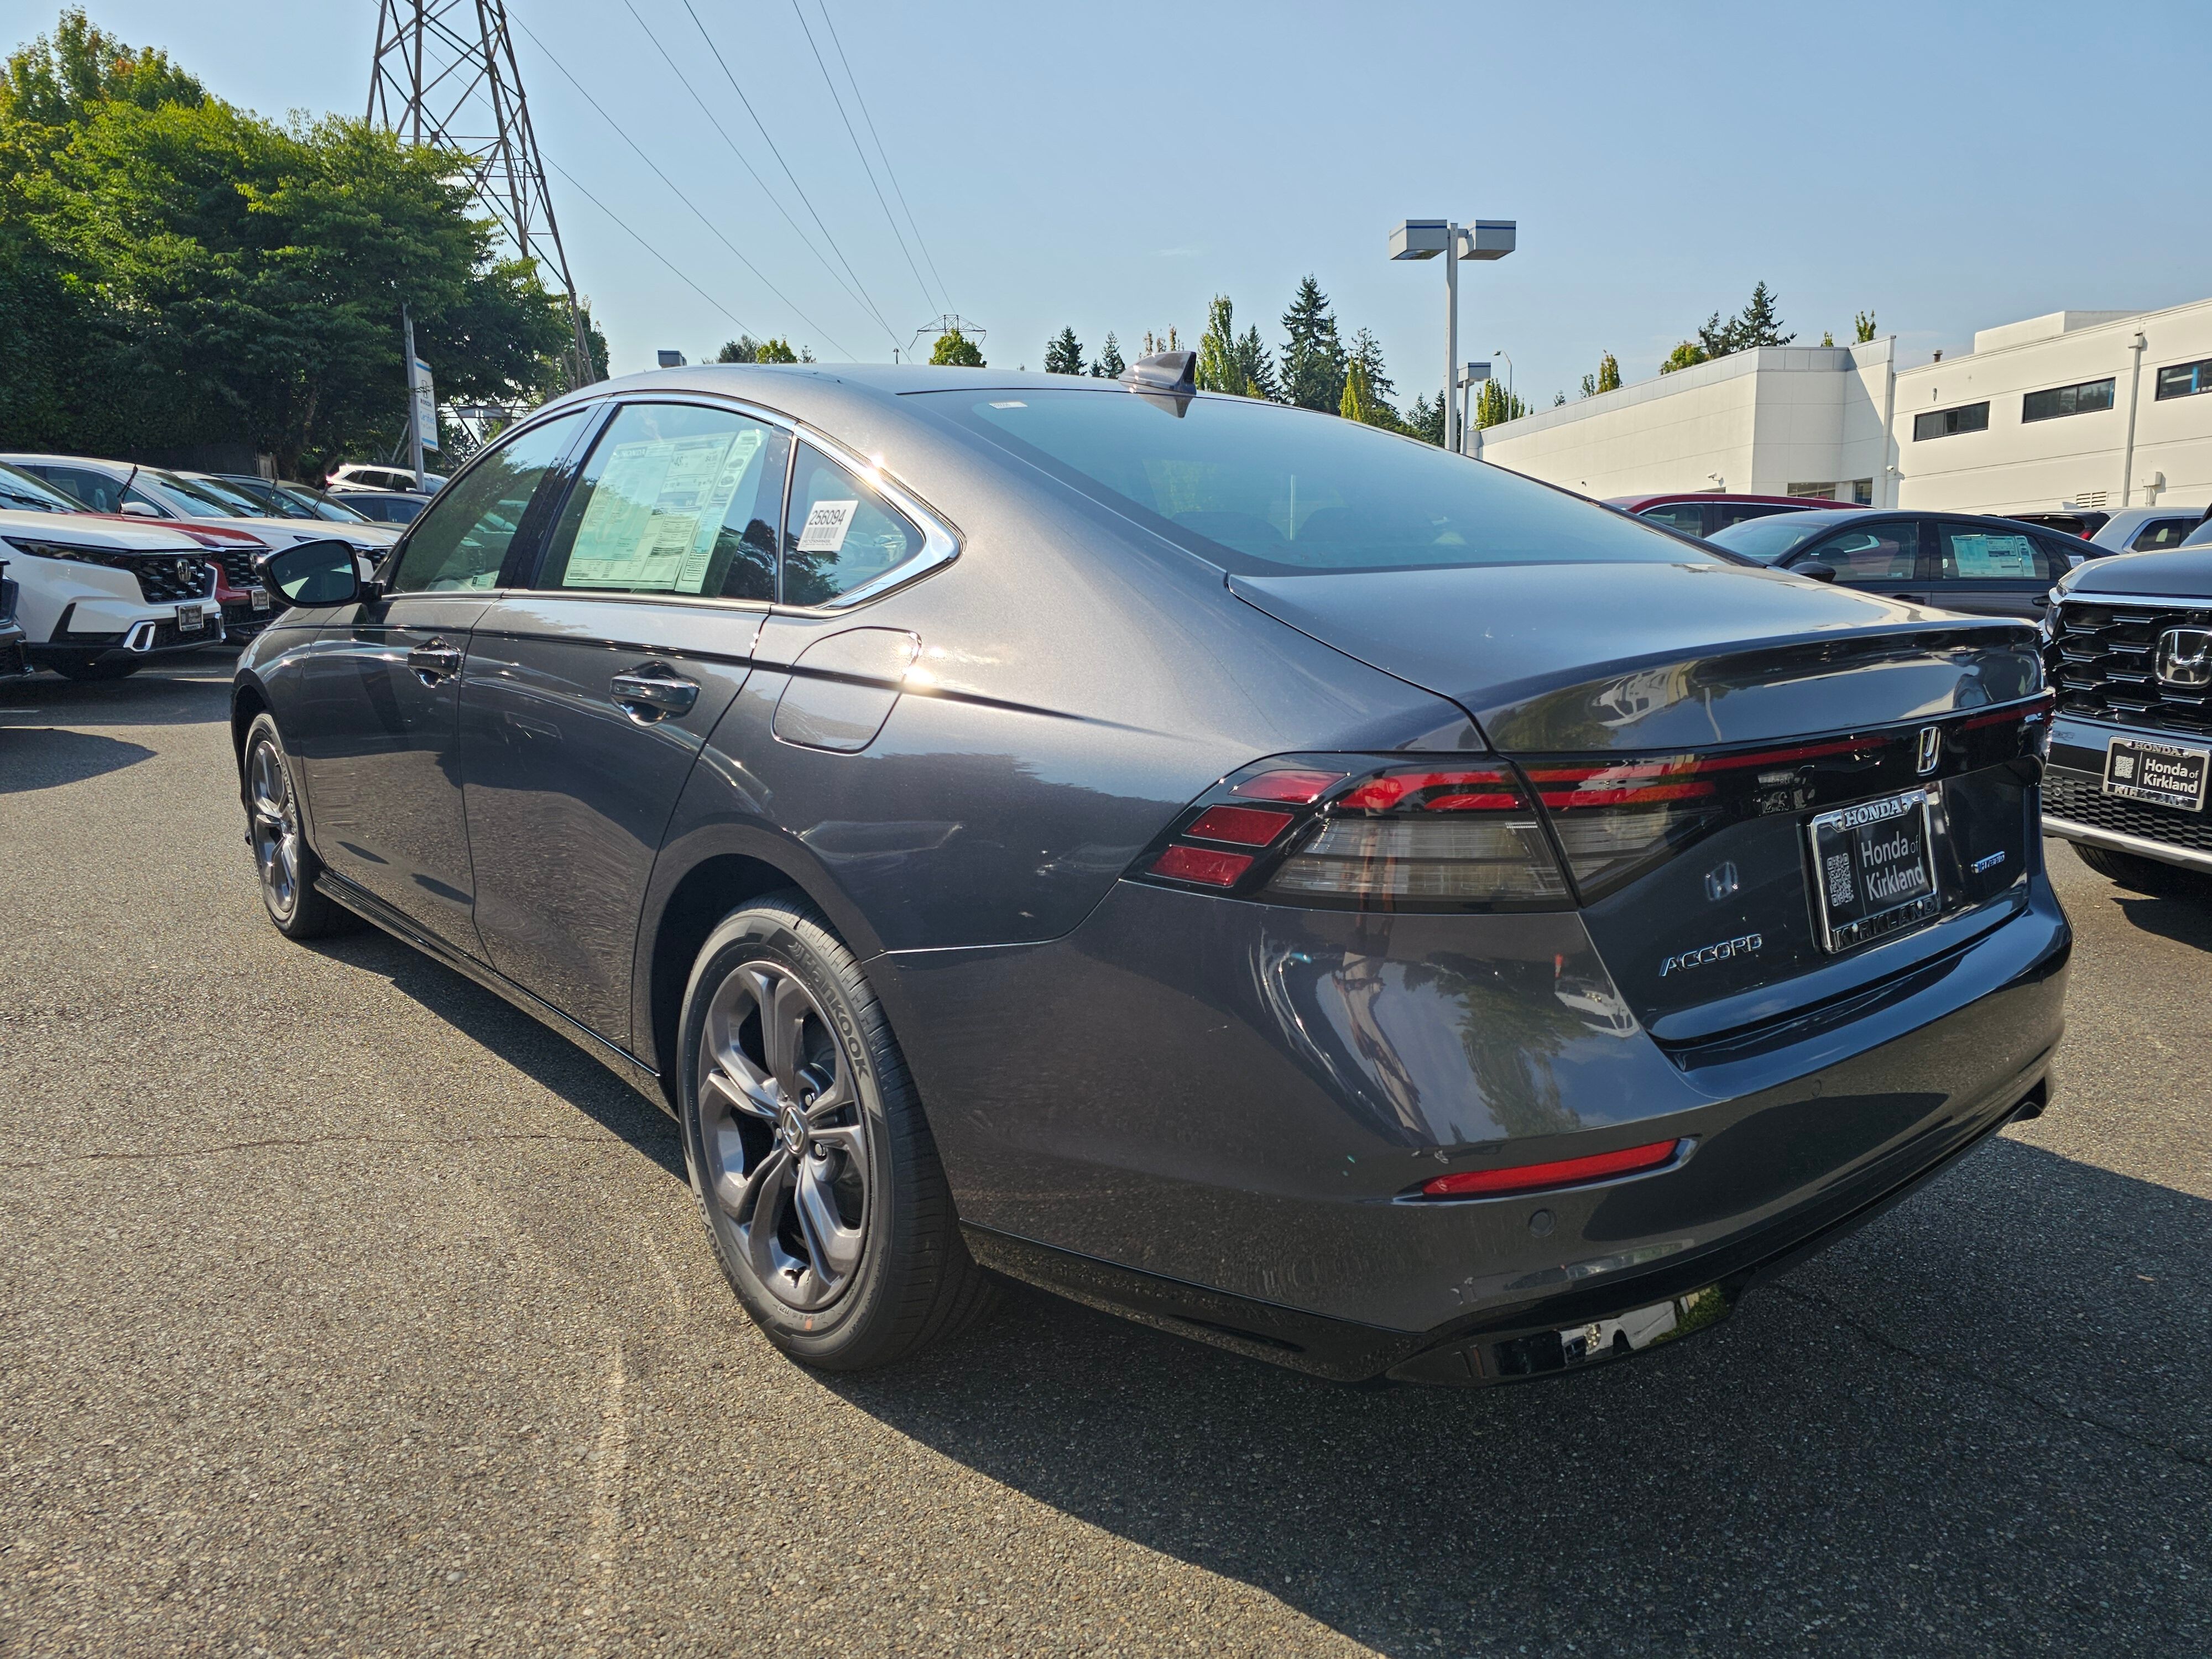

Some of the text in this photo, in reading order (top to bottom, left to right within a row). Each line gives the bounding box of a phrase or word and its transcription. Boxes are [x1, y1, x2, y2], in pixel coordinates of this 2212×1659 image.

[808, 509, 847, 525] 256094
[2134, 742, 2182, 756] HONDA
[2145, 758, 2200, 779] Honda of
[2143, 773, 2199, 794] Kirkland
[1844, 800, 1903, 827] HONDA
[1861, 831, 1919, 868] Honda of
[1866, 857, 1926, 901] Kirkland
[1658, 933, 1763, 977] ACCORD
